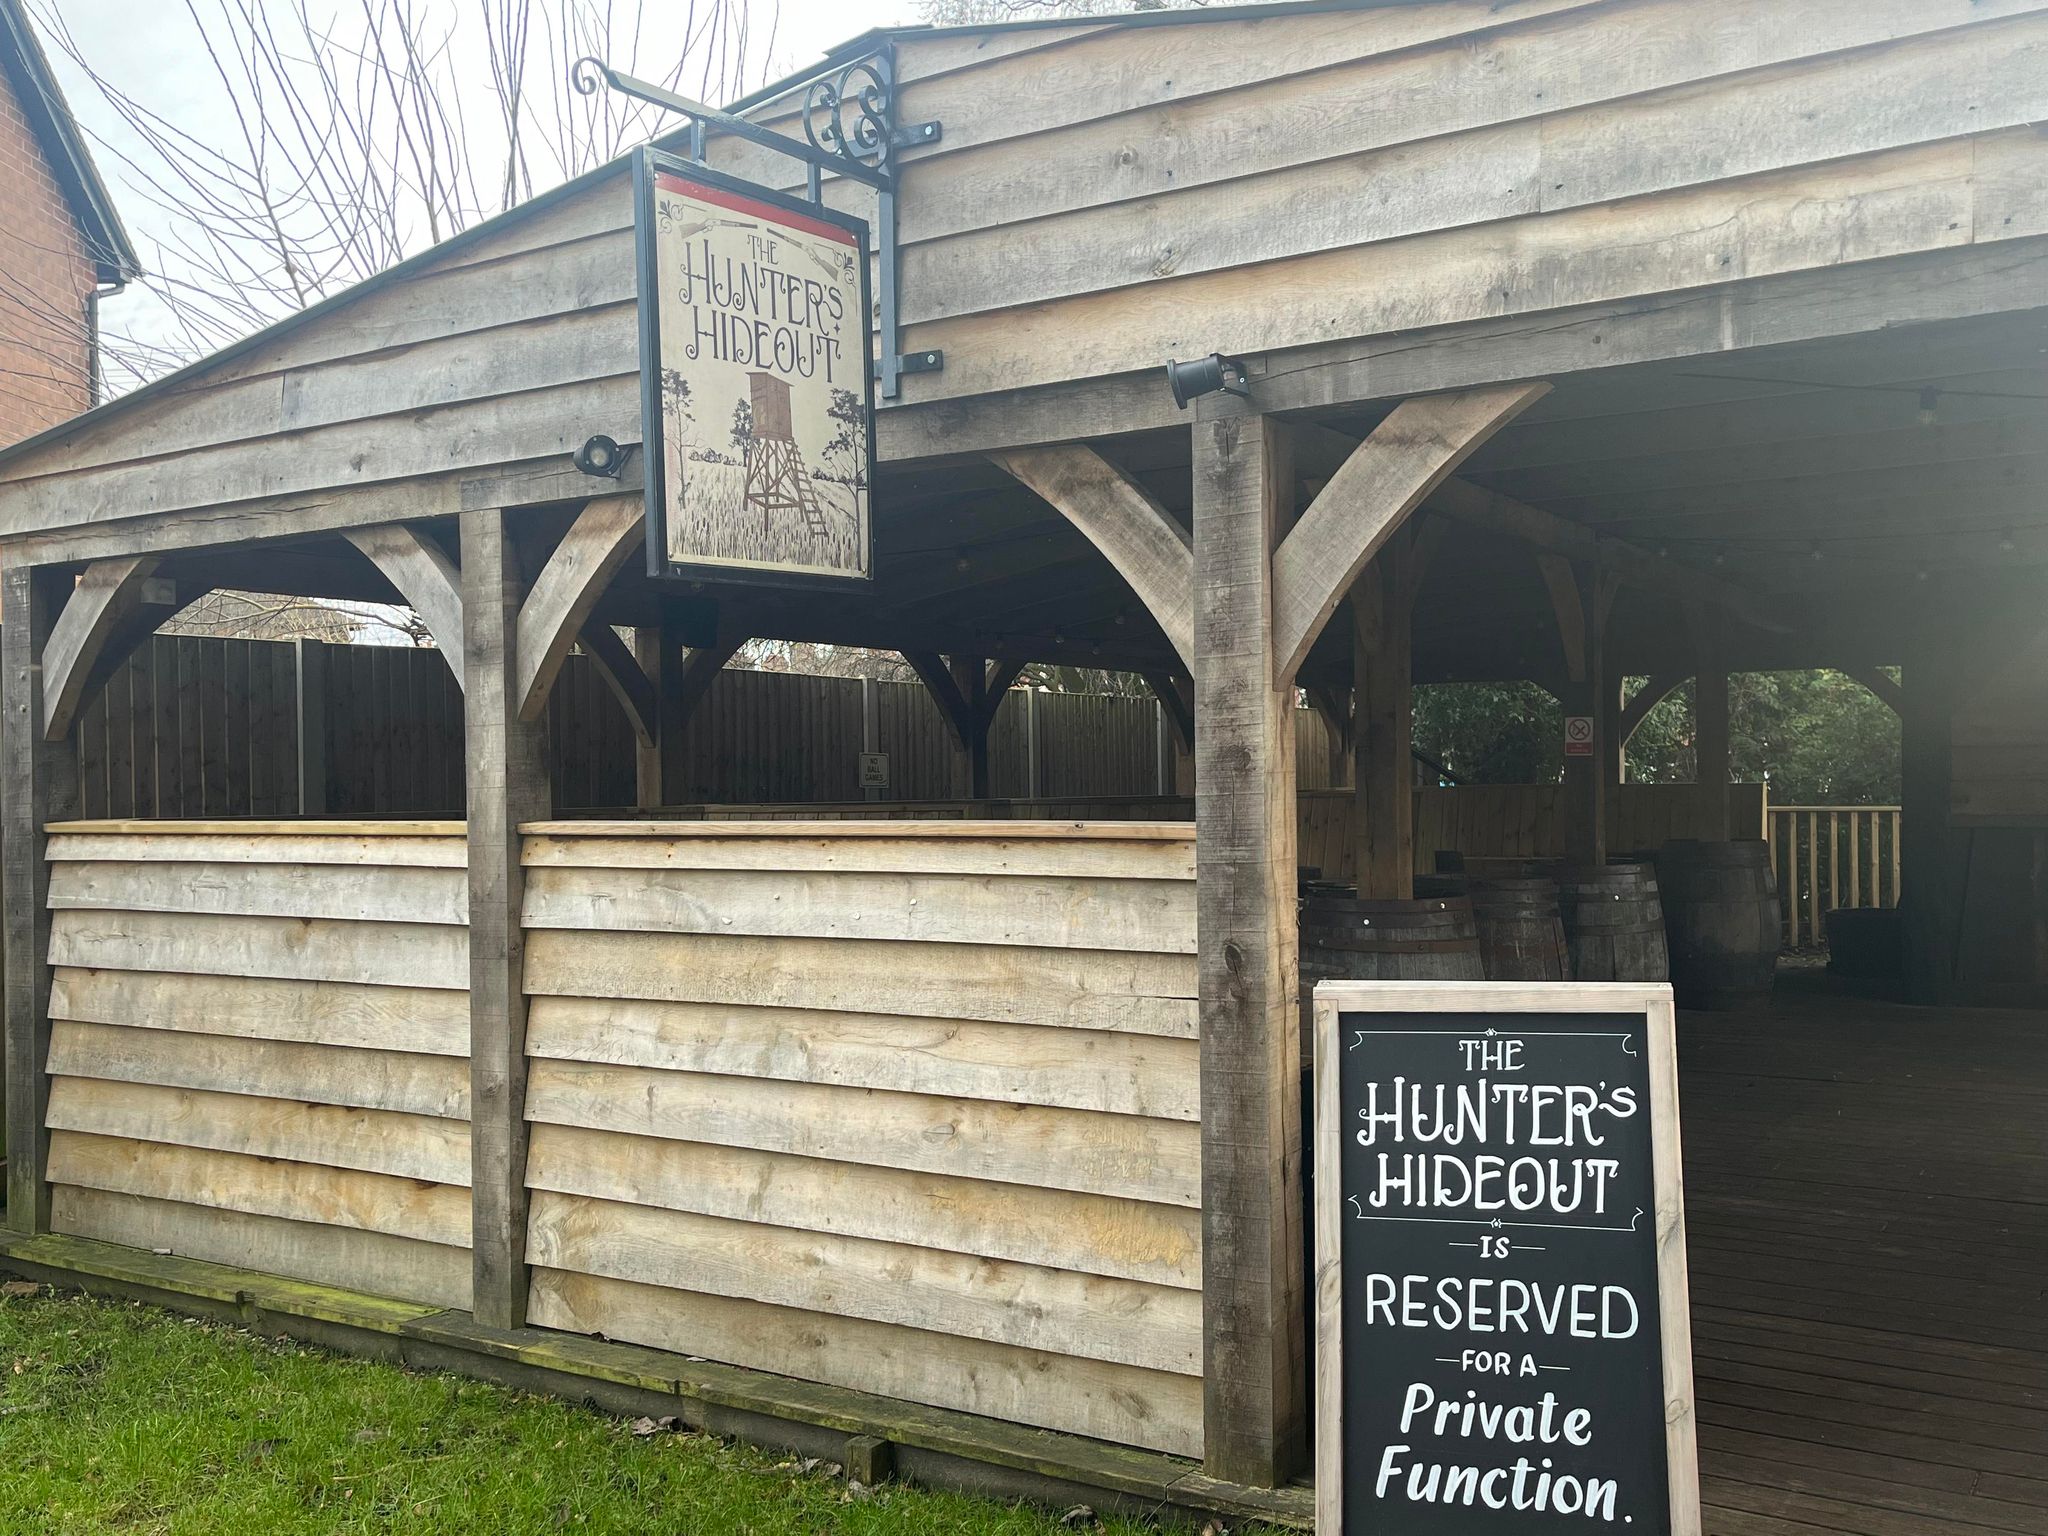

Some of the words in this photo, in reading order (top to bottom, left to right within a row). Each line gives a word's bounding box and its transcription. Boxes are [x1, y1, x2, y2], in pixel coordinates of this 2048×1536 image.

[747, 234, 779, 265] THE
[679, 239, 843, 336] HUNTER'S
[685, 305, 842, 384] HIDEOUT
[865, 774, 883, 782] GAMES
[1458, 1039, 1526, 1072] THE
[1356, 1076, 1638, 1147] HUNTER'S
[1368, 1152, 1620, 1215] HIDEOUT
[1479, 1235, 1511, 1259] IS
[1365, 1272, 1640, 1340] RESERVED
[1461, 1349, 1511, 1376] FOR
[1518, 1353, 1538, 1378] A
[1399, 1382, 1593, 1447] Private
[1374, 1443, 1634, 1524] Function.
